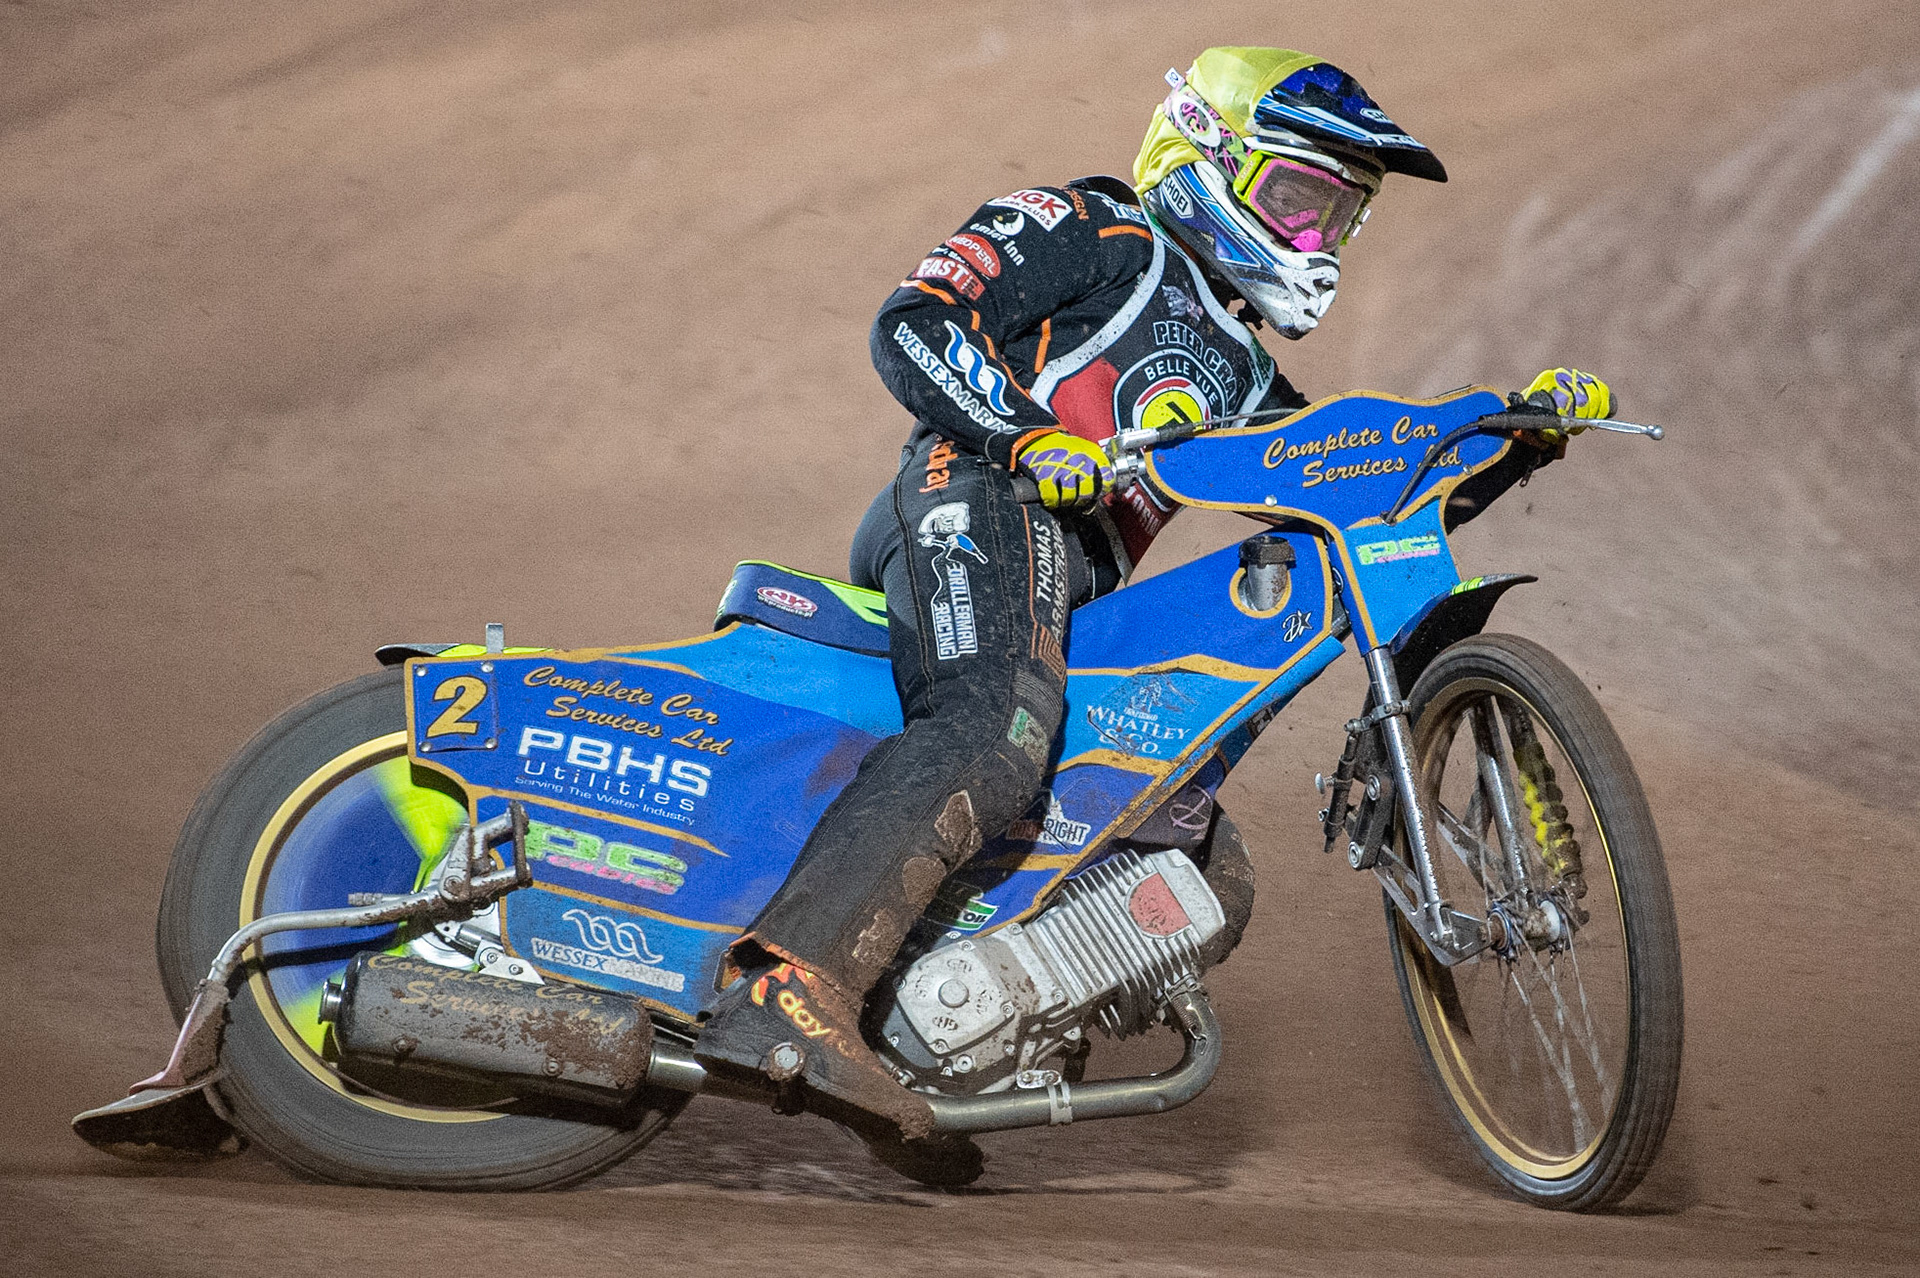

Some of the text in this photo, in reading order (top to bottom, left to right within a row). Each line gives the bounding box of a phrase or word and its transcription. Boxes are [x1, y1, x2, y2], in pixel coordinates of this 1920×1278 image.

[1021, 205, 1051, 226] PLUGS
[916, 257, 970, 283] FAST
[1003, 240, 1025, 266] Inn
[1153, 321, 1203, 360] PETER
[1144, 359, 1219, 405] BELLE VUE
[1263, 416, 1439, 469] Complete Car
[1302, 456, 1408, 488] Services
[1033, 521, 1051, 602] THOMAS
[935, 601, 955, 657] RACING
[946, 562, 976, 651] DRILLERMAN
[426, 676, 488, 739] 2
[523, 666, 720, 725] Complete Car
[546, 697, 733, 756] Services Ltd
[1087, 705, 1192, 739] WHATLEY
[517, 726, 713, 797] PBHS
[524, 760, 695, 812] Utilities
[515, 776, 695, 826] Serving The Water Industry
